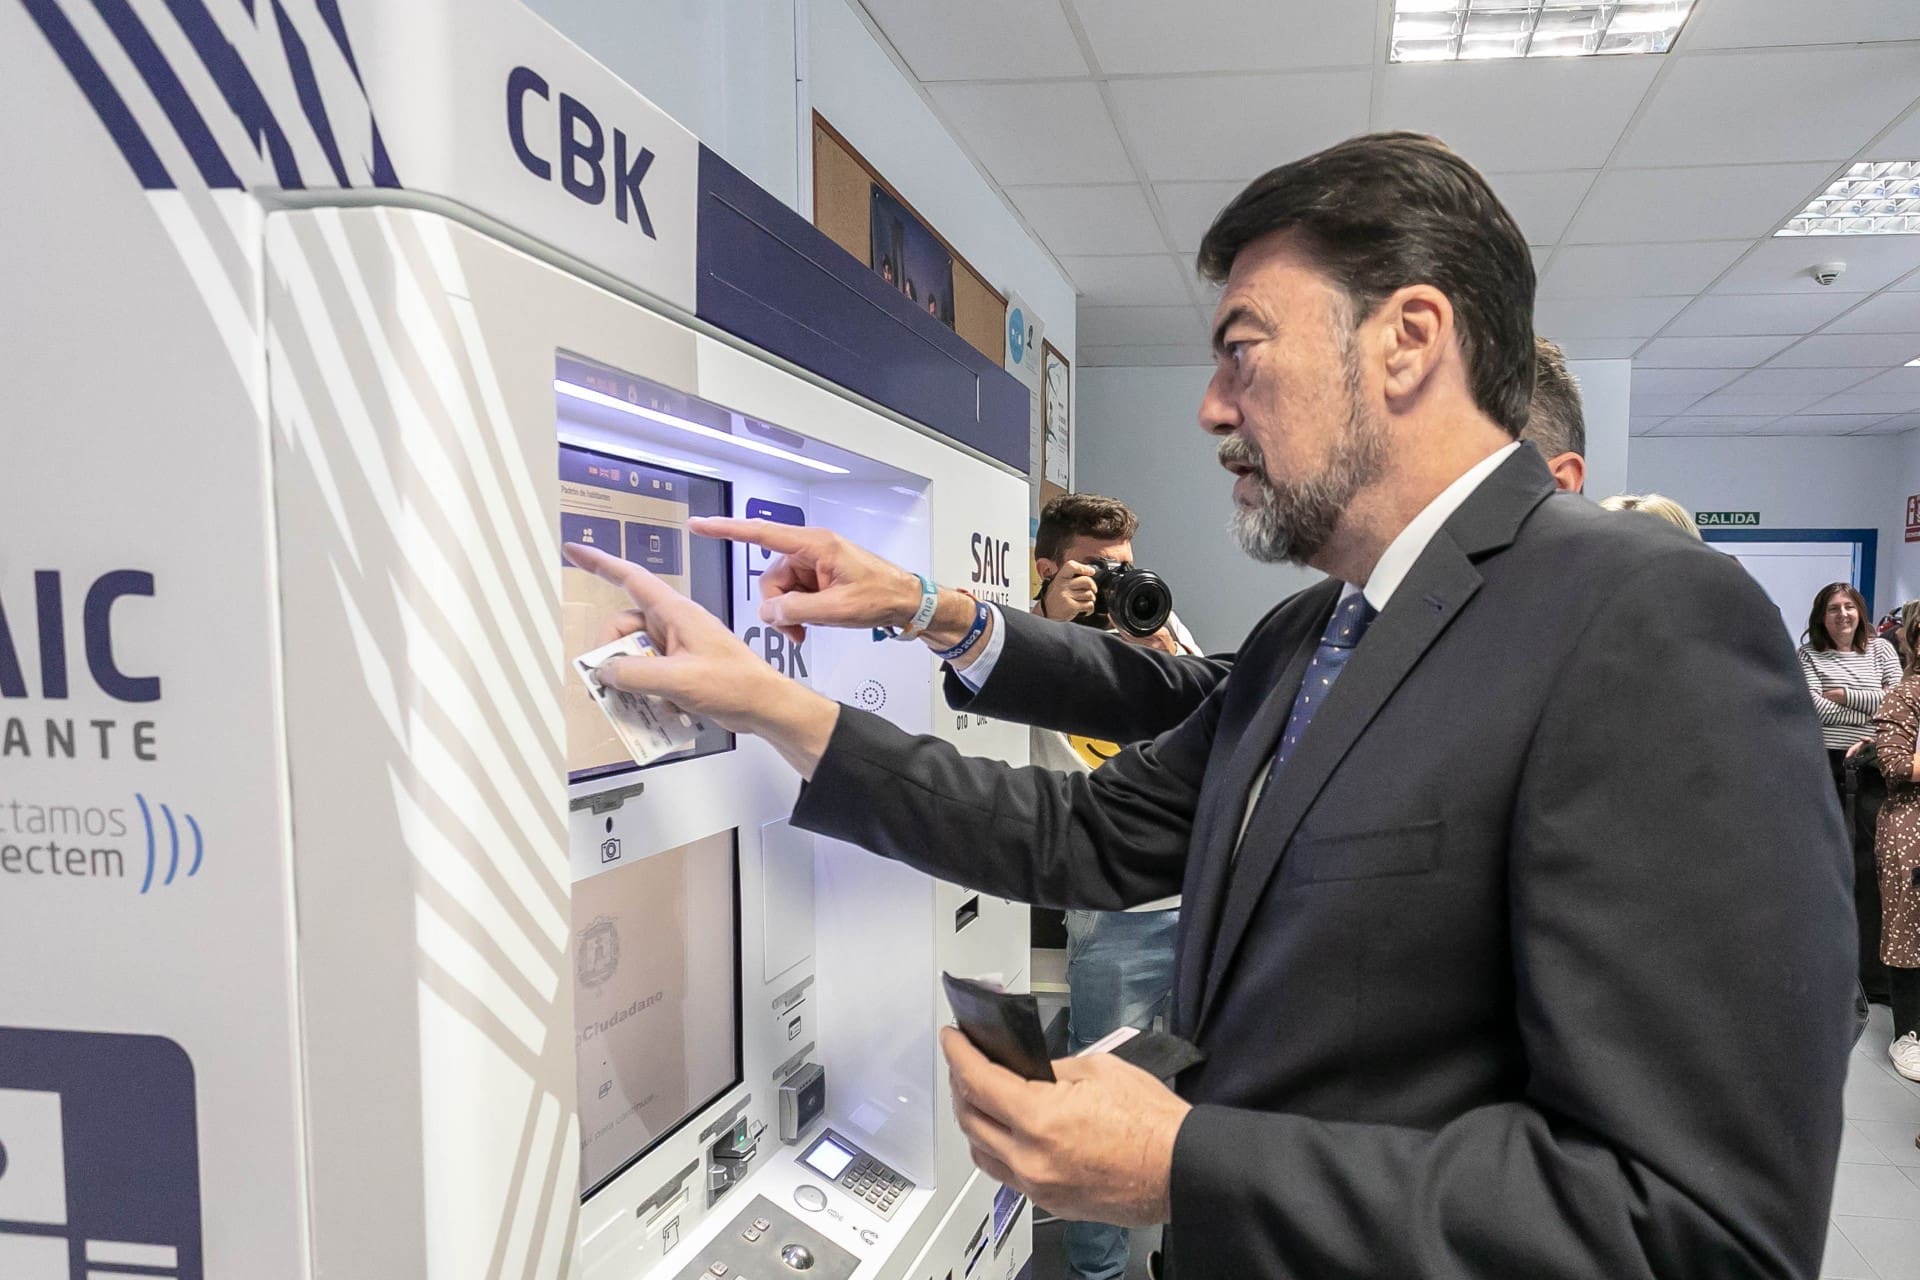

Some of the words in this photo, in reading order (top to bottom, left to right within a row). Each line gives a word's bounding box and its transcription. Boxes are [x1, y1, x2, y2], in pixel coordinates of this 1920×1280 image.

[506, 65, 657, 241] CBK
[1698, 513, 1757, 524] SALIDA
[971, 532, 1010, 588] SAIC
[2, 717, 158, 761] ANTE
[956, 713, 969, 731] 010
[0, 842, 125, 877] ectem
